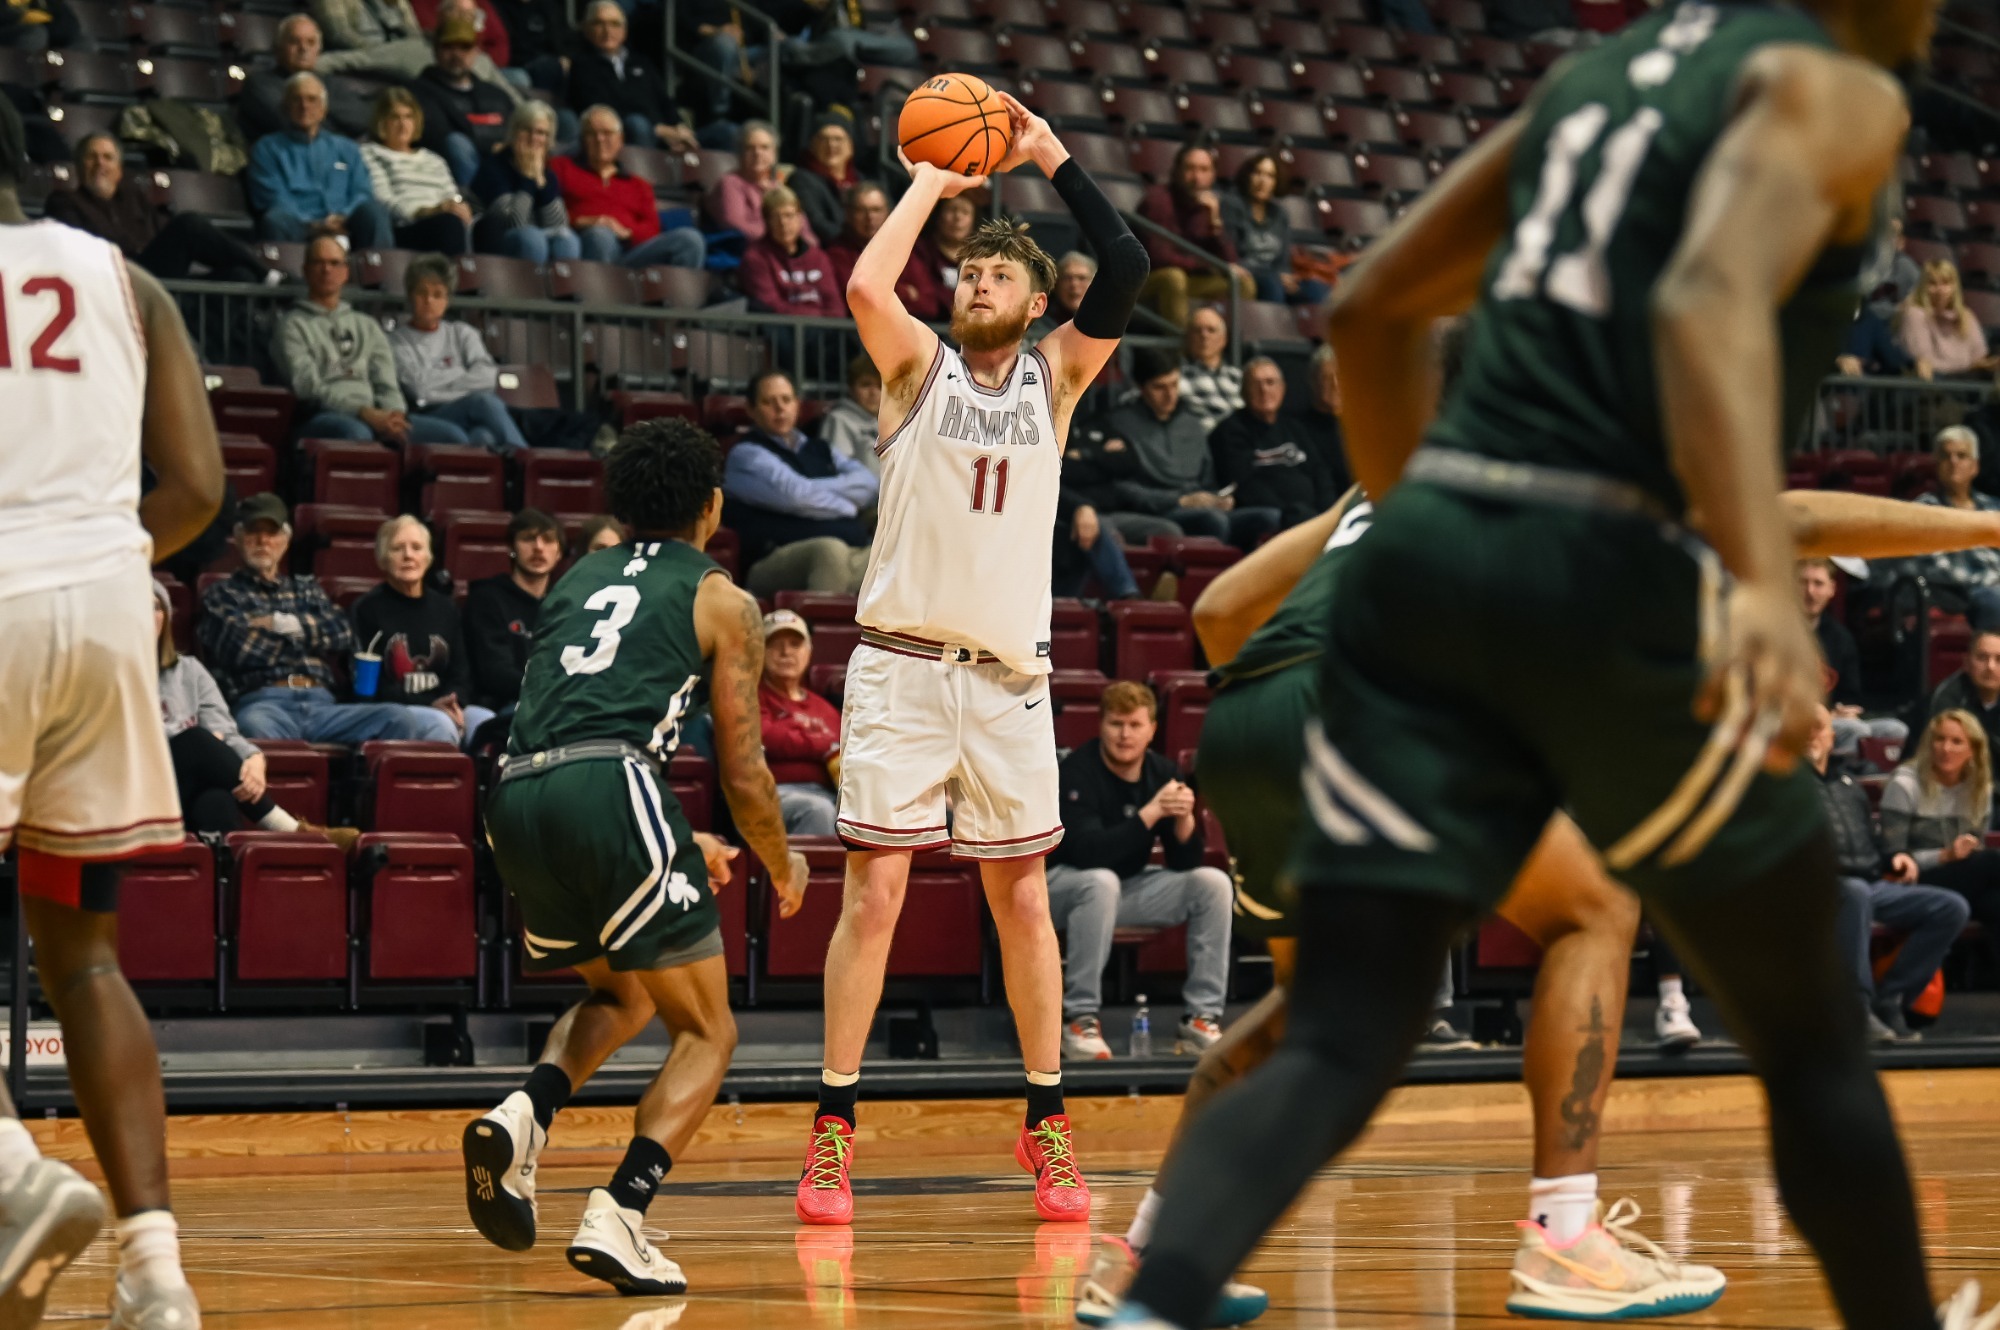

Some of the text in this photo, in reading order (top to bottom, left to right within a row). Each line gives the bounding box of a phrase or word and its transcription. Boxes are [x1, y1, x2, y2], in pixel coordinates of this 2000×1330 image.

[1492, 103, 1664, 317] 11
[938, 395, 1040, 446] HAWKS
[969, 454, 1011, 516] 11
[559, 584, 642, 676] 3
